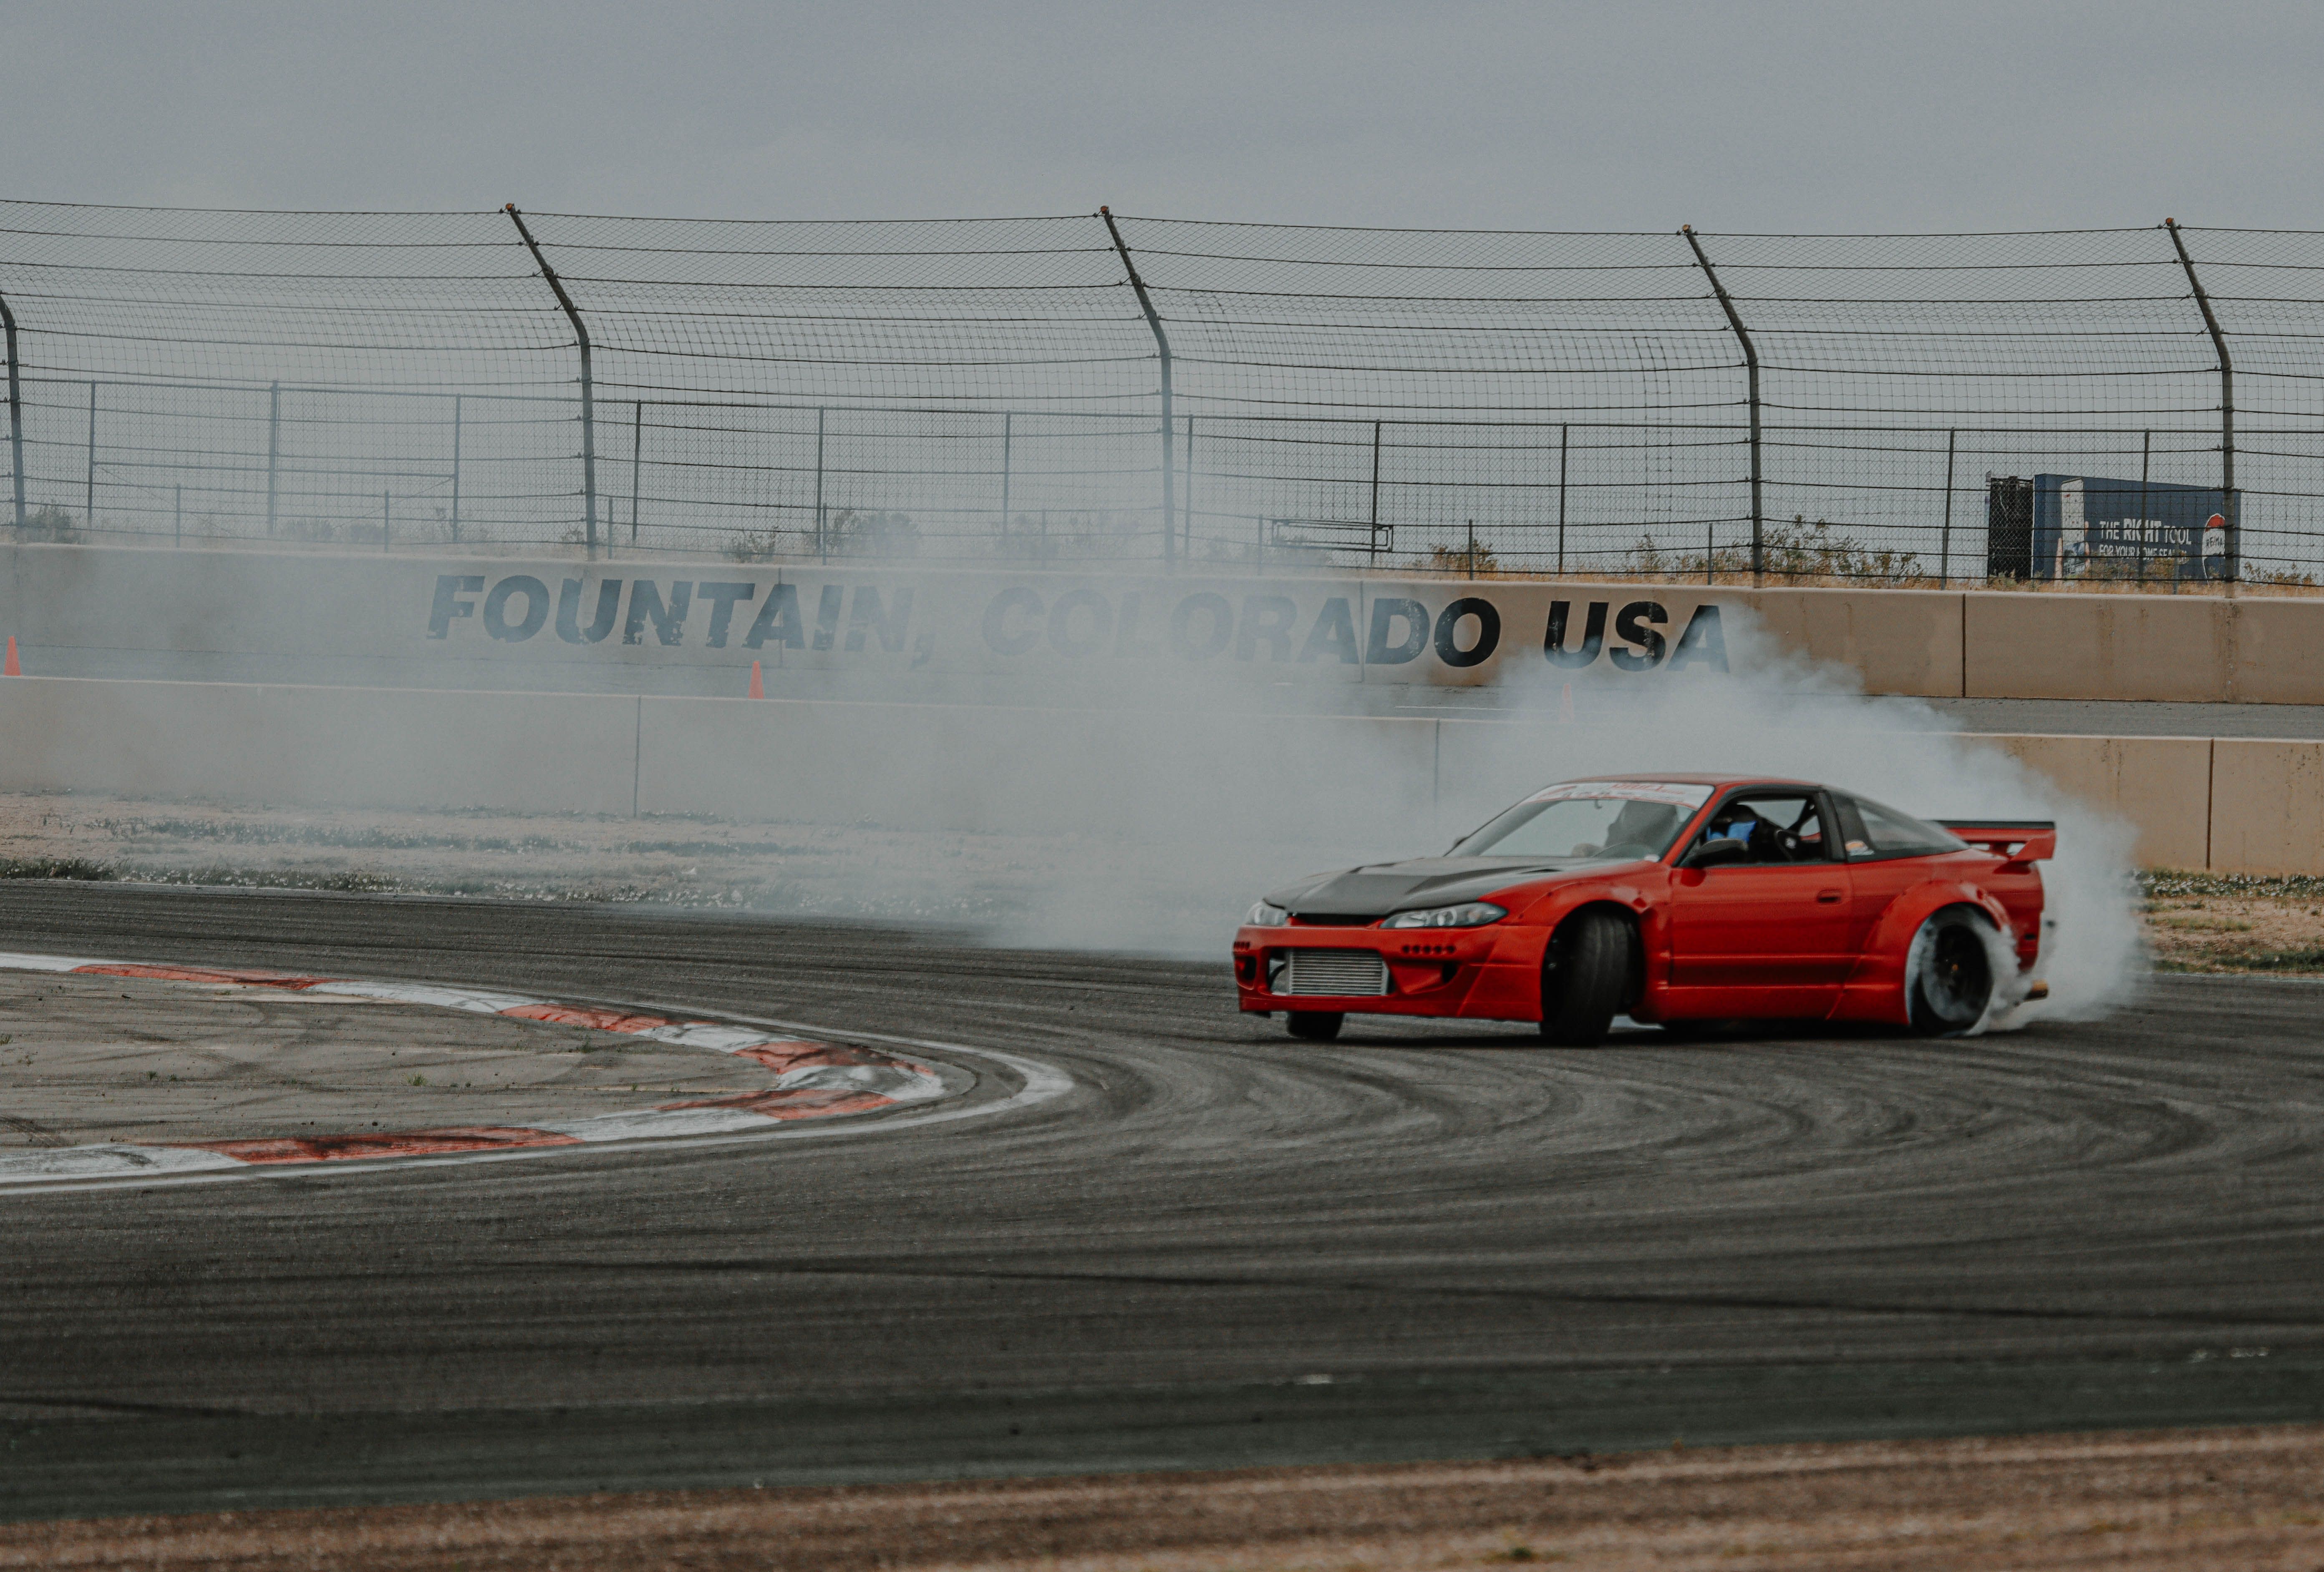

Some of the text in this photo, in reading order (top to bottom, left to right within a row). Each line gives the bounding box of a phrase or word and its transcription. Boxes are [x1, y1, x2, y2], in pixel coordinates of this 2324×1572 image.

[2099, 518, 2192, 544] THE RIGHT TOOL
[2099, 544, 2114, 557] FOR
[2115, 545, 2135, 559] YOUR
[426, 574, 1730, 673] FOUNTAIN, COLORADO USA
